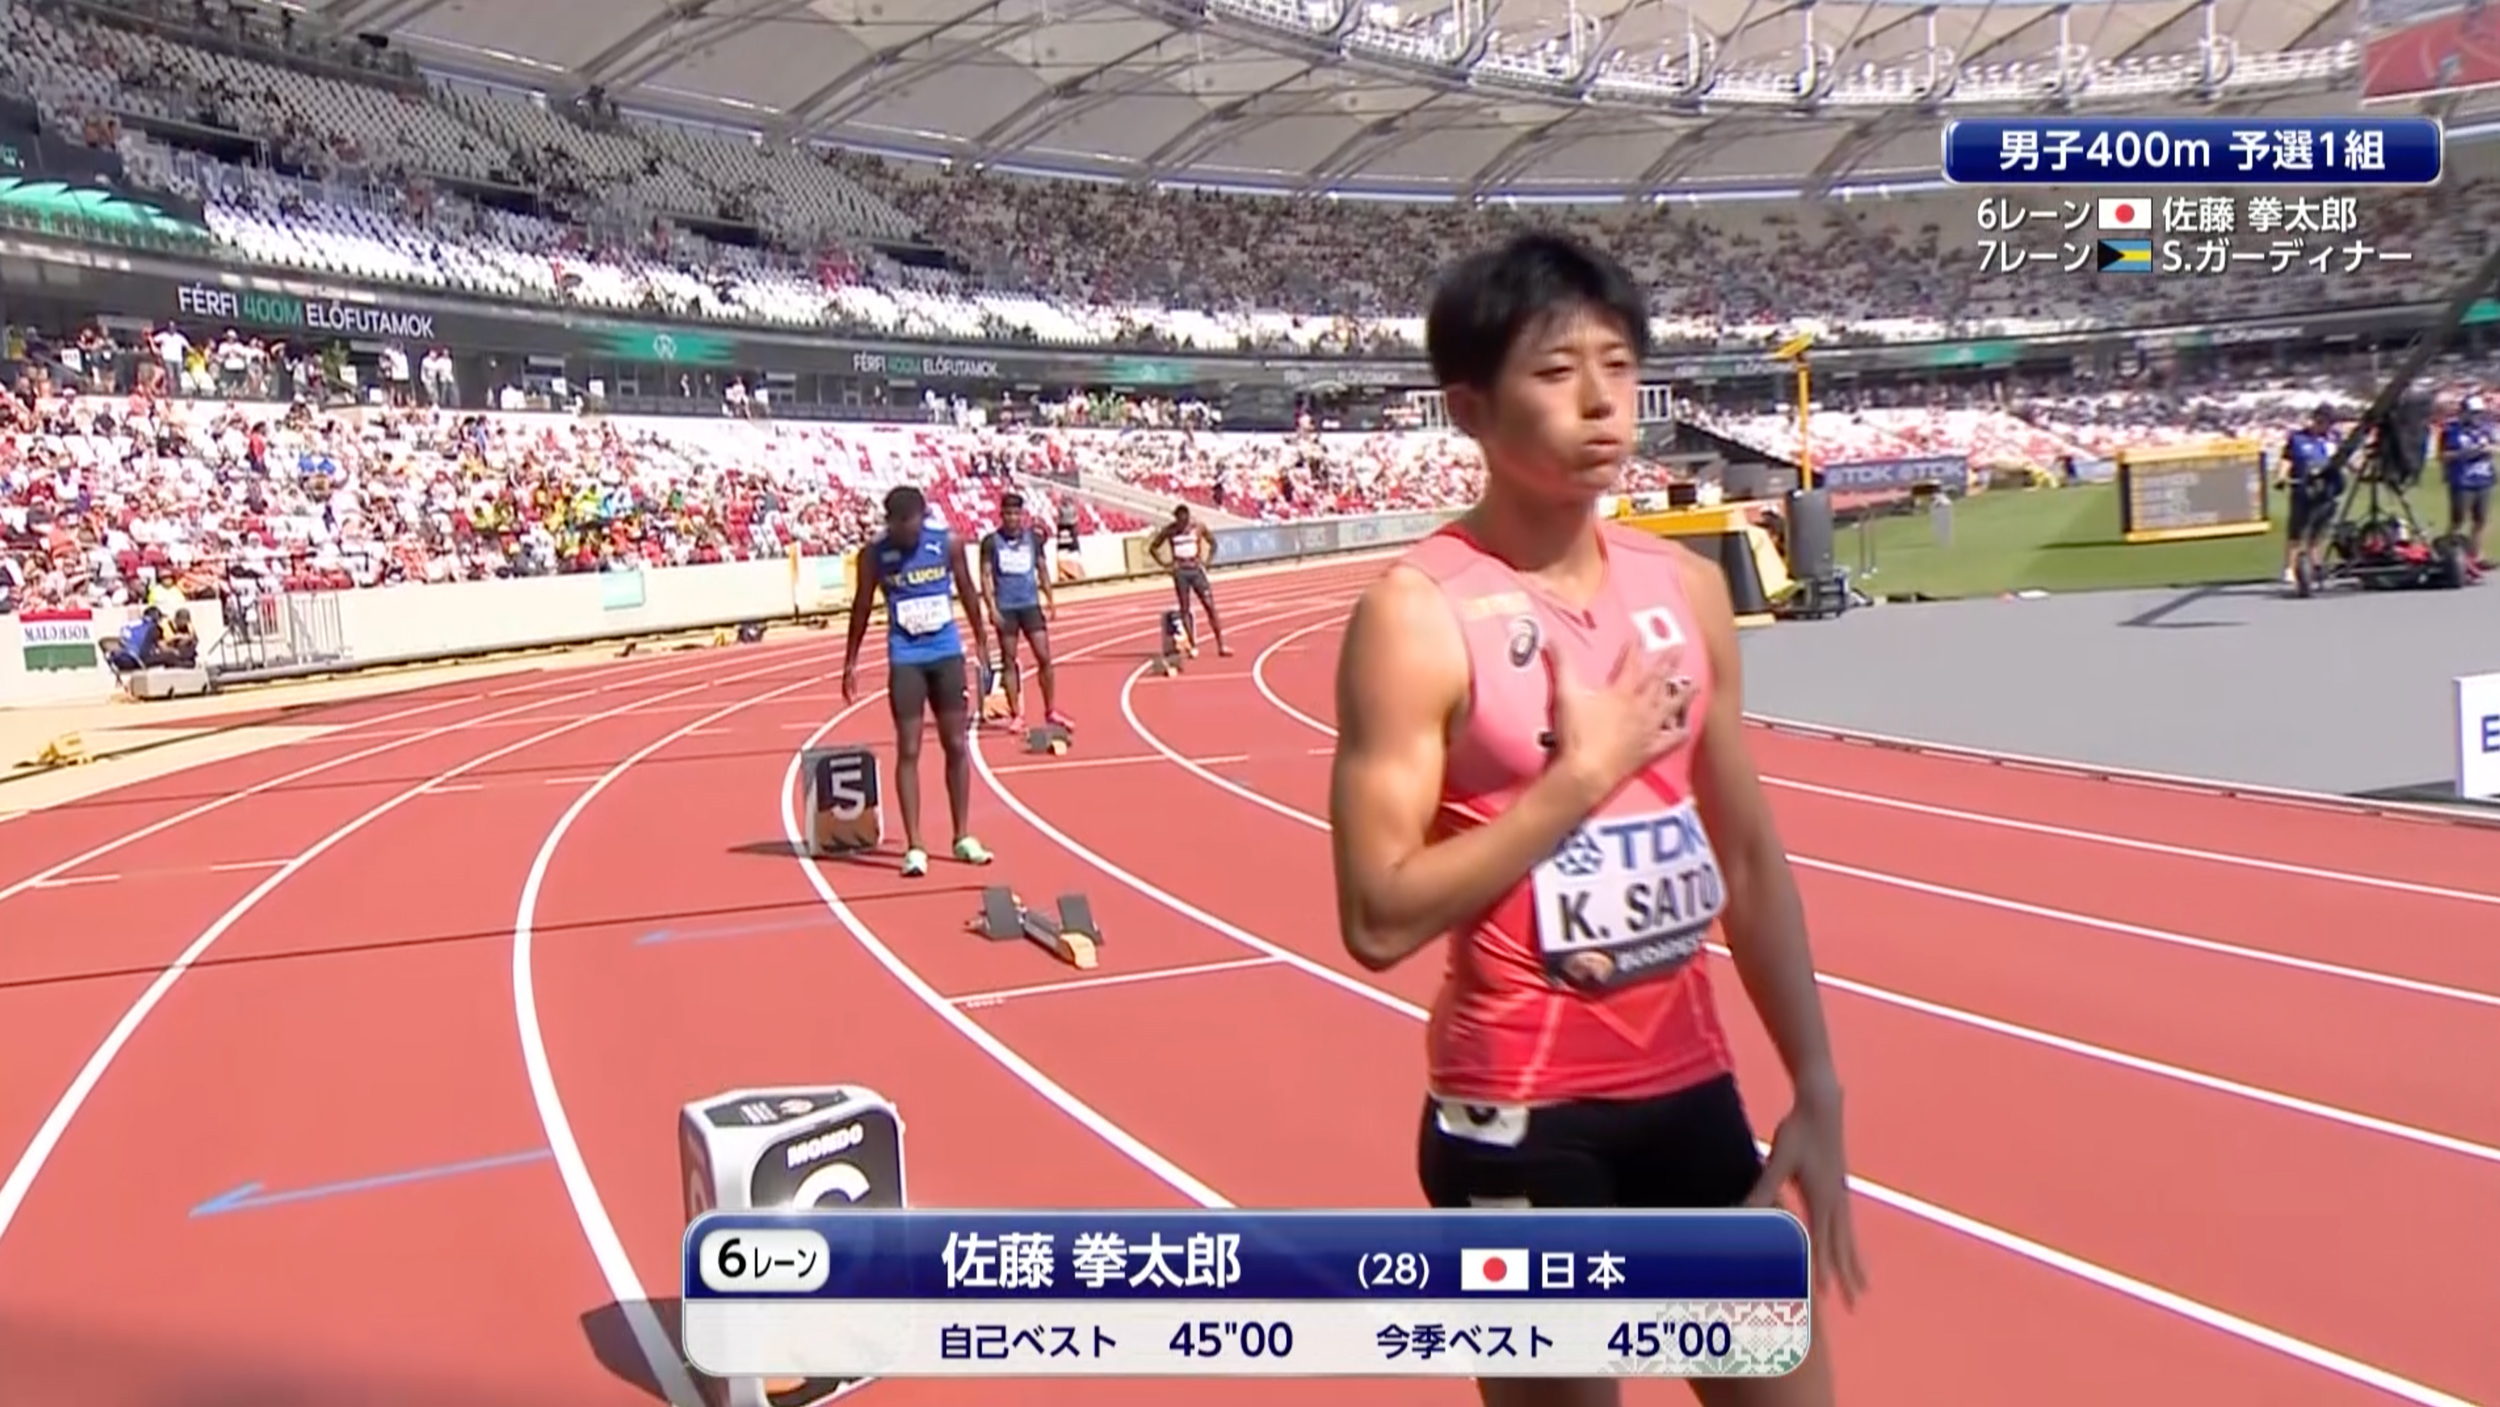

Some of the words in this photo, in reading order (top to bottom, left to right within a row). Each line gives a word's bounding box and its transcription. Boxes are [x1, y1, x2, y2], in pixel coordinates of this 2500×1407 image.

[178, 283, 239, 319] FÉRFI
[243, 295, 303, 328] 400M
[831, 769, 865, 821] 5
[1557, 891, 1612, 942] K.
[1624, 862, 1719, 932] SATO
[787, 1122, 864, 1169] MONDO
